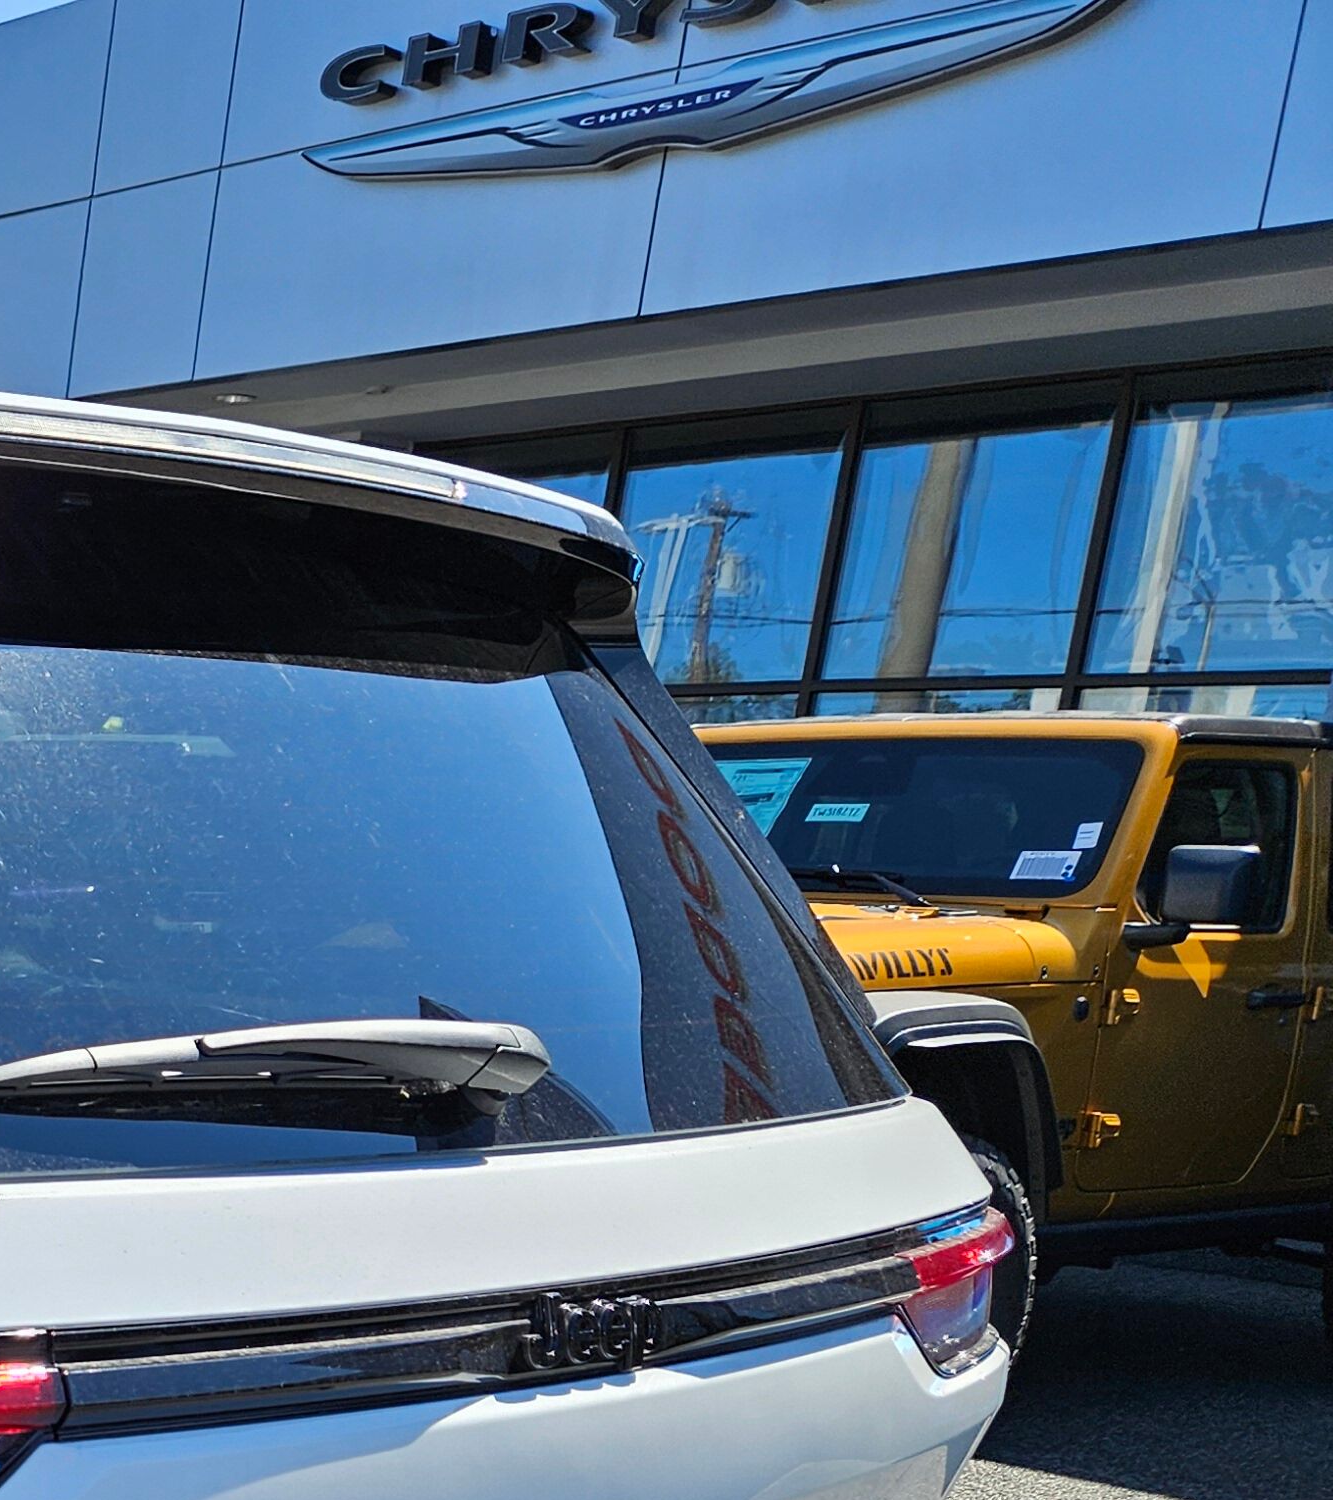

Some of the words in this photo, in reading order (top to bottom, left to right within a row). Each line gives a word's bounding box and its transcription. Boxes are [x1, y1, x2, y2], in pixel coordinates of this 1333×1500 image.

[579, 89, 731, 127] CHRYSLER
[847, 947, 953, 981] WILLYS
[523, 1291, 662, 1370] Jeep
